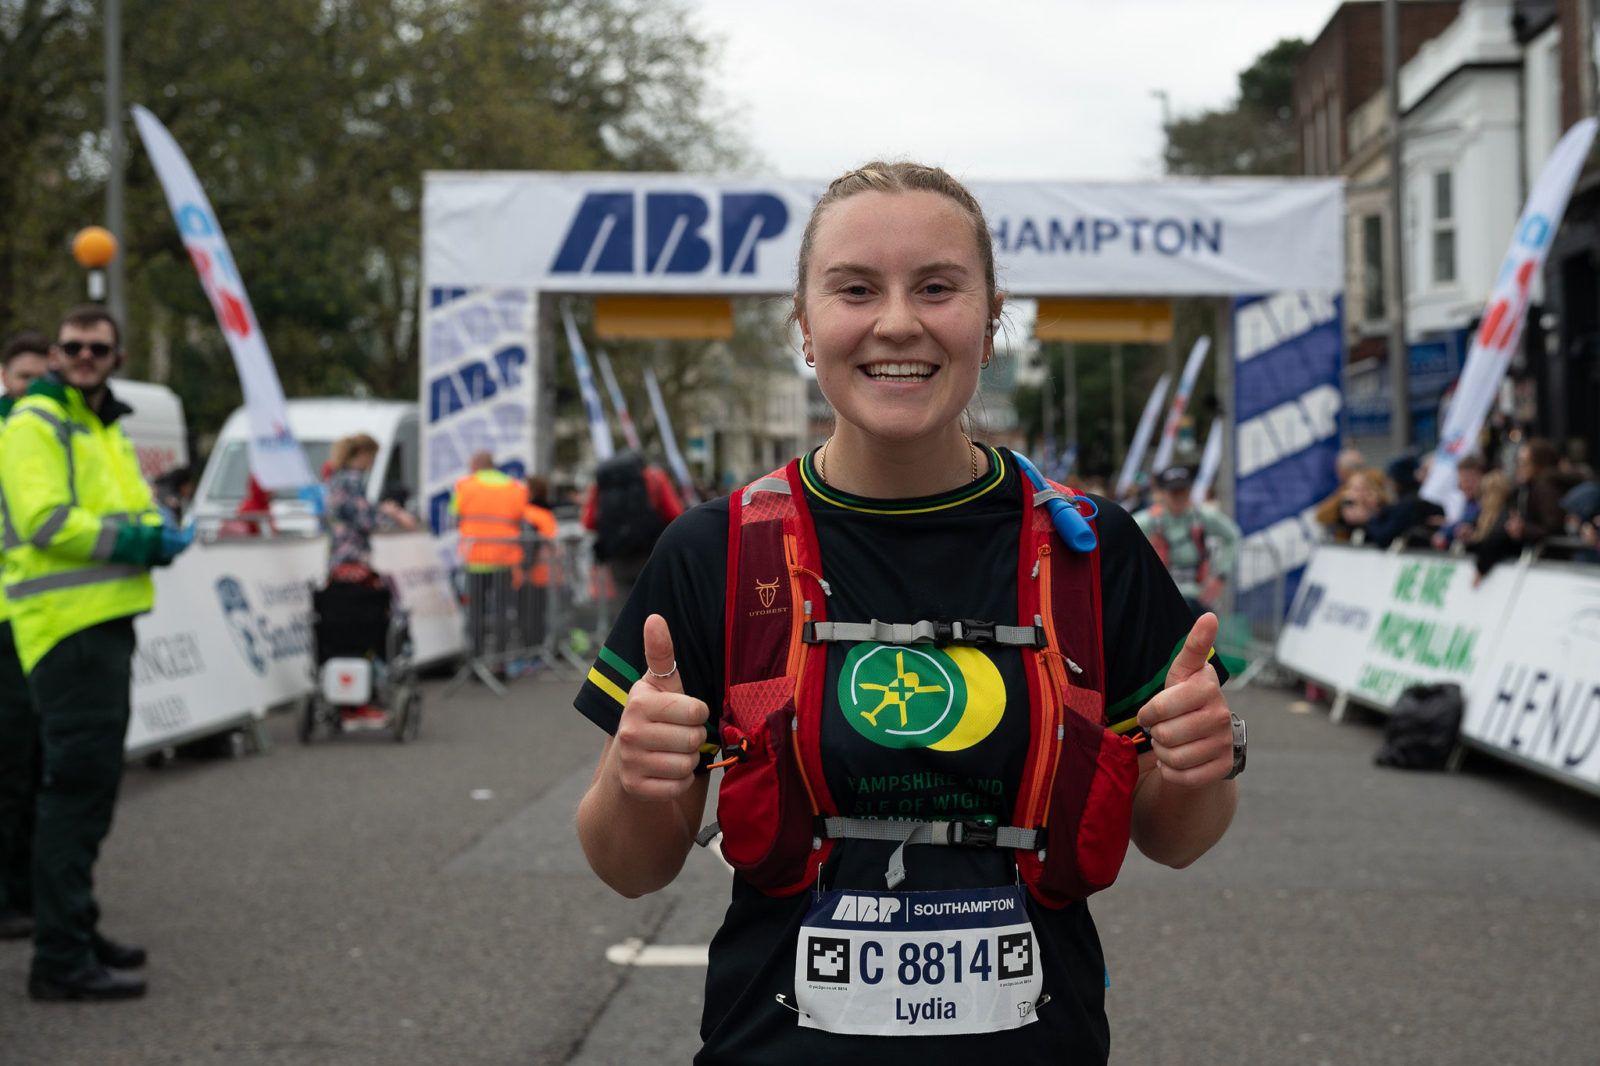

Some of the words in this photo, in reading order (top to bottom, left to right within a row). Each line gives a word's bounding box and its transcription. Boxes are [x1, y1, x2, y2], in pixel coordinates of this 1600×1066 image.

[549, 191, 789, 275] ABP
[991, 217, 1223, 256] HAMPTON
[428, 345, 526, 425] ABP
[1235, 384, 1341, 478] ABP
[854, 799, 889, 814] SLE
[898, 798, 925, 813] OF
[932, 792, 1001, 811] WIGH
[831, 895, 901, 923] ABP
[914, 898, 1014, 916] SOUTHAMPTON
[859, 940, 884, 985] C
[898, 938, 992, 985] 8814
[896, 997, 956, 1024] Lydia
